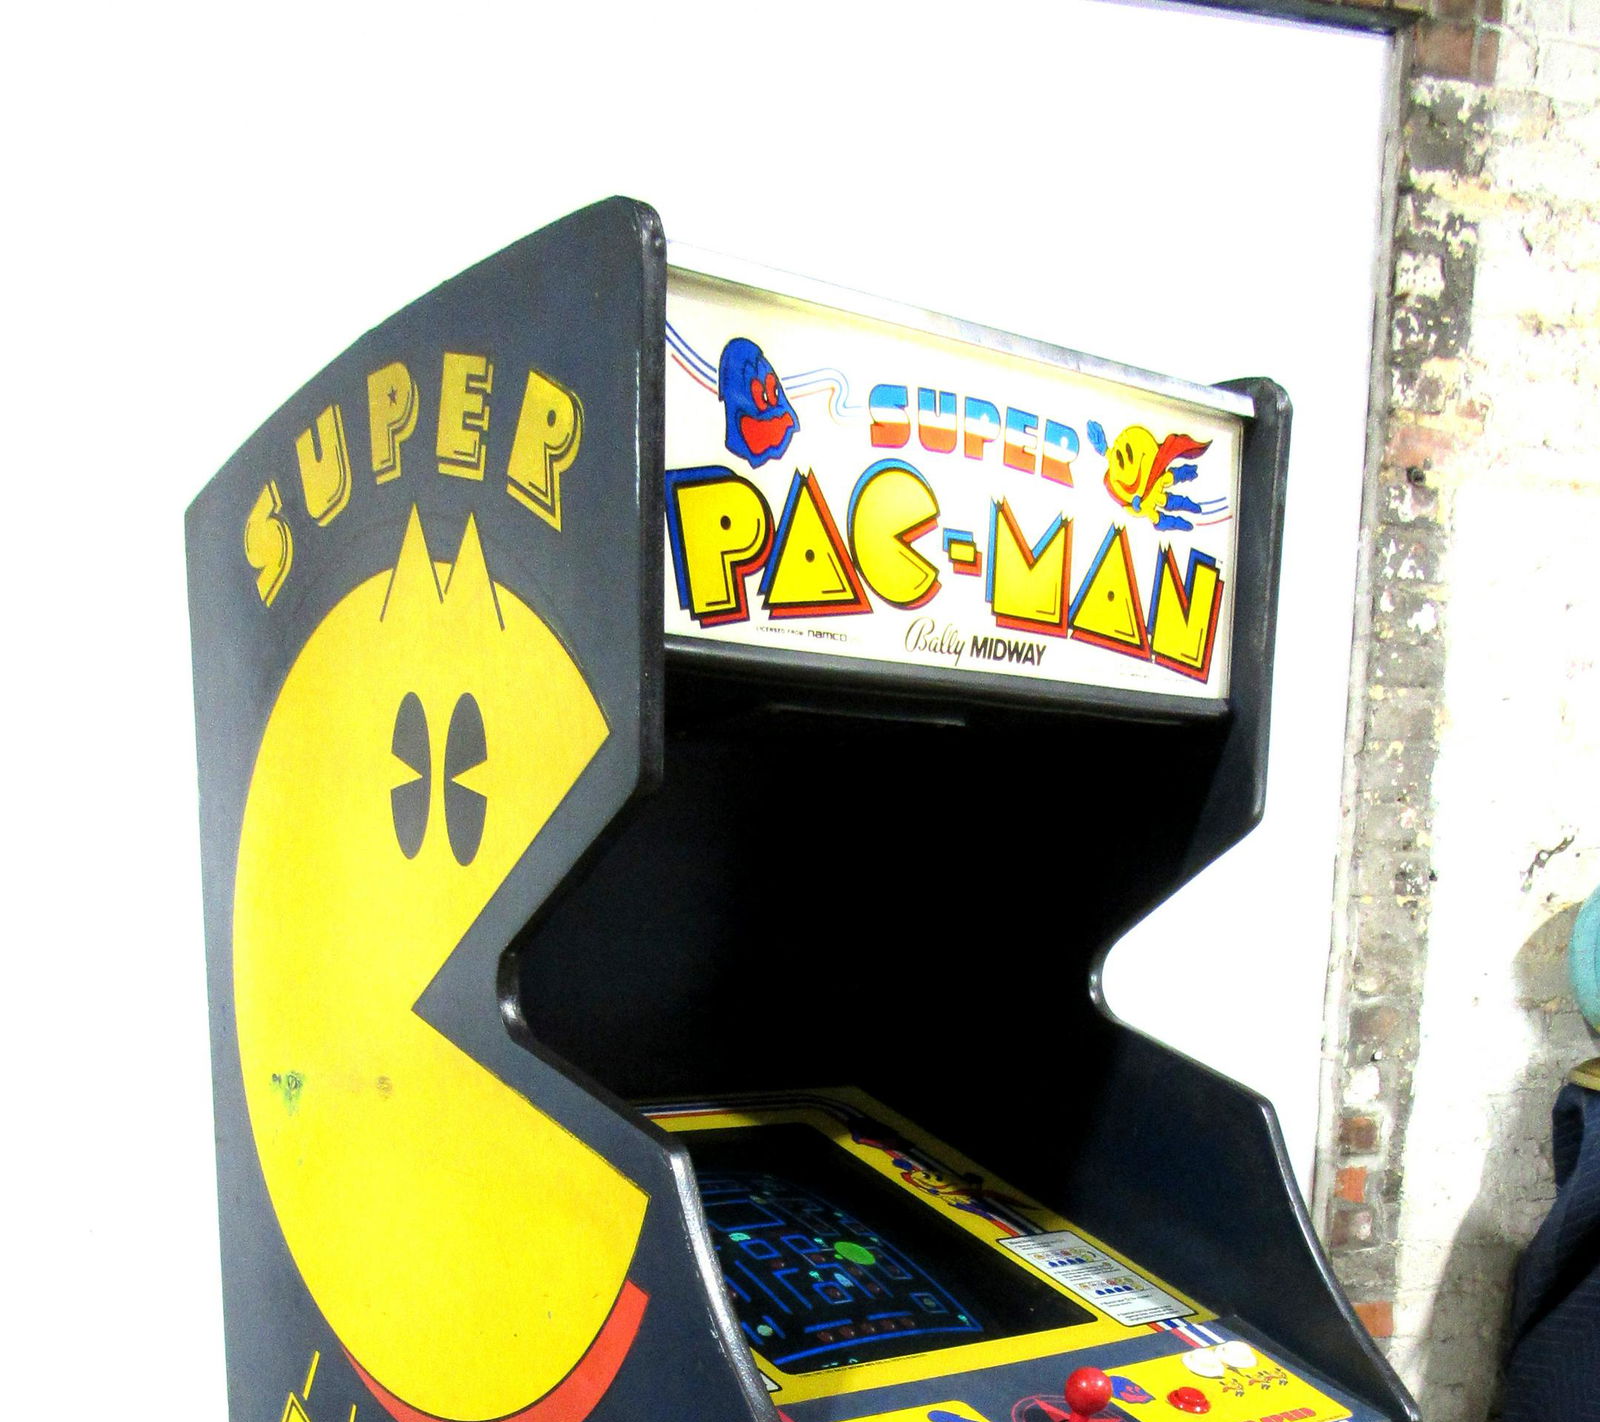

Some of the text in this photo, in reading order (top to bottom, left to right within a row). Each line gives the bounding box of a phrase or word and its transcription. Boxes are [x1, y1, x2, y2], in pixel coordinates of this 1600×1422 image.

[244, 352, 585, 608] SUPER
[868, 383, 1080, 489] SUPER
[664, 456, 1225, 685] PAC-MAN
[807, 629, 848, 642] namco
[904, 615, 1047, 667] Bally MIDWAY
